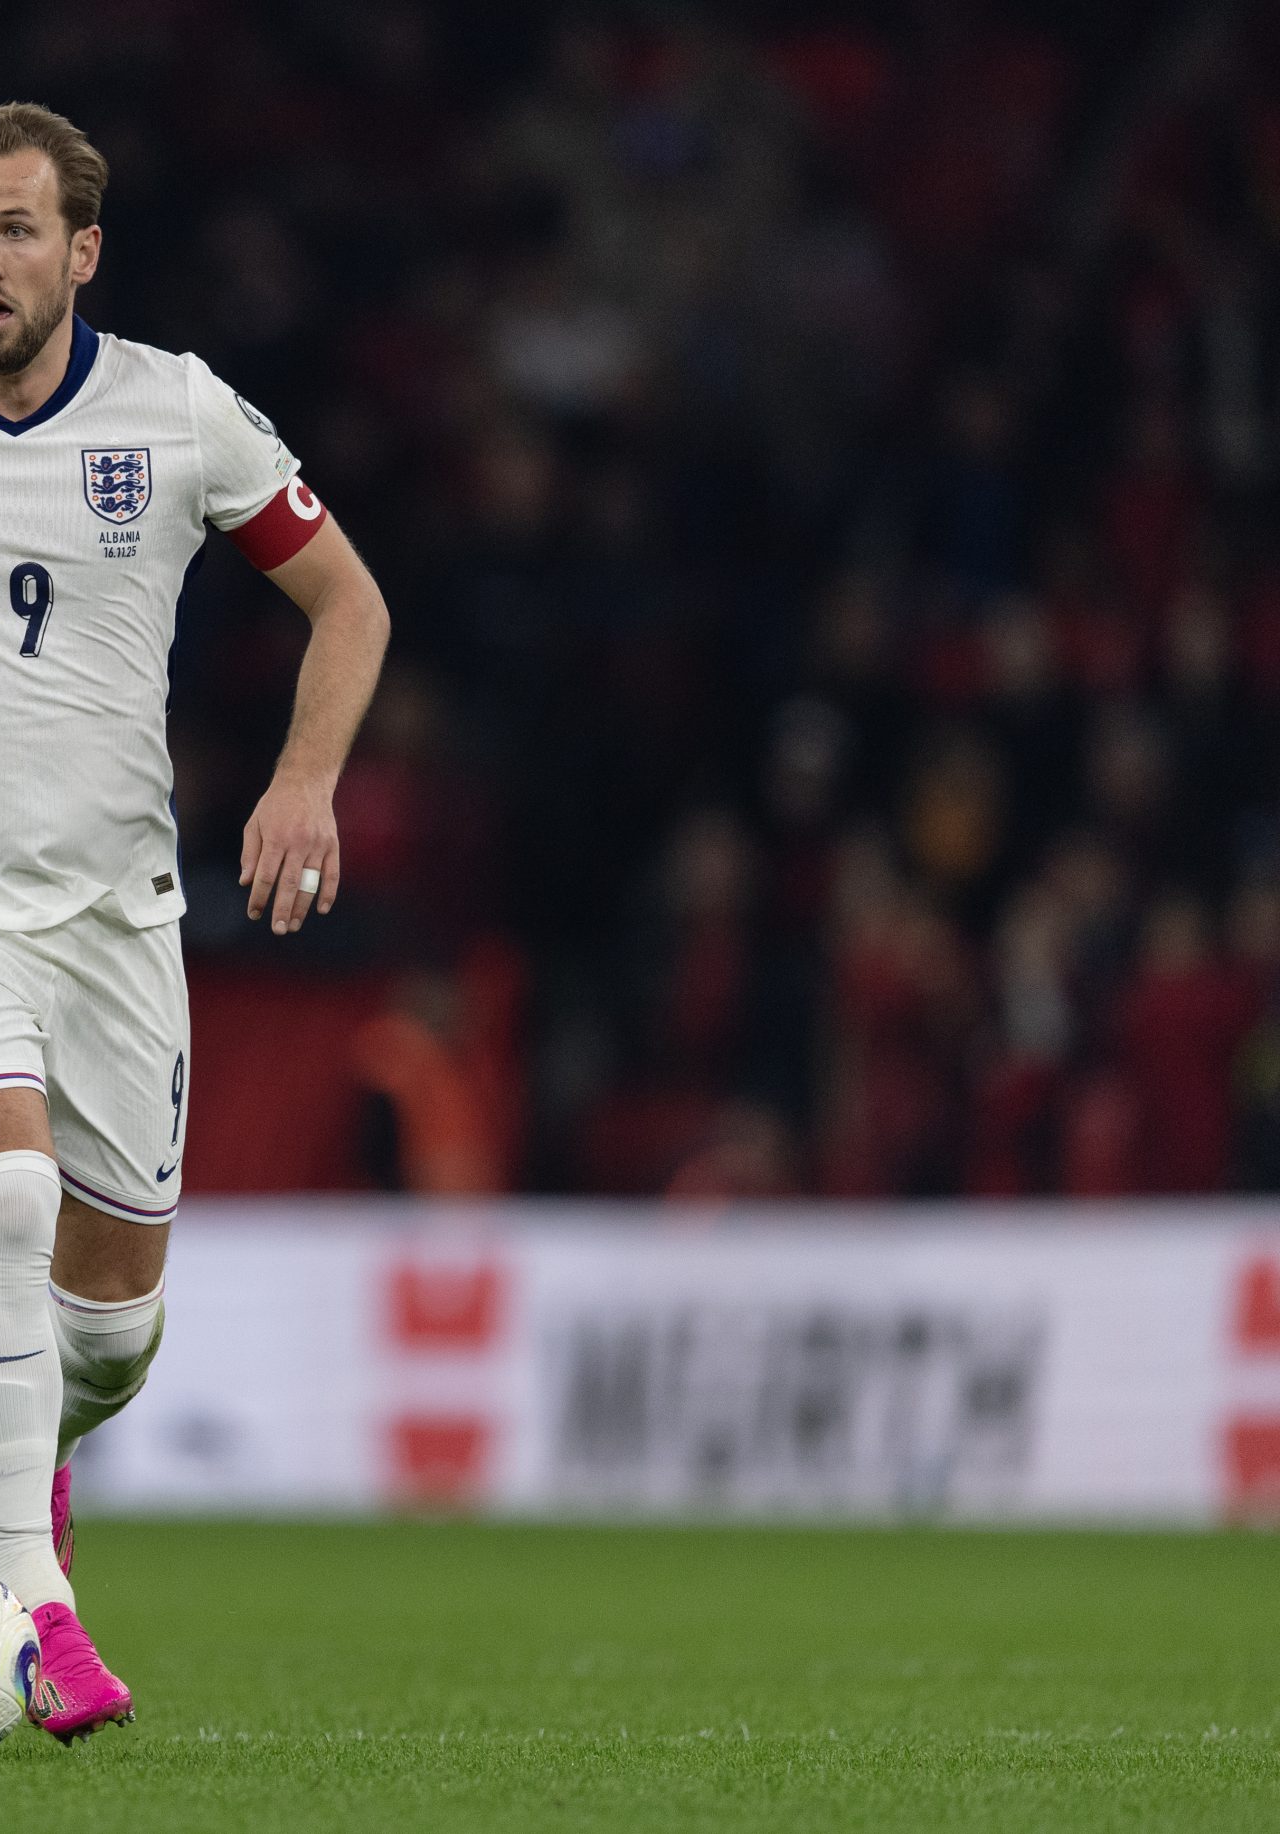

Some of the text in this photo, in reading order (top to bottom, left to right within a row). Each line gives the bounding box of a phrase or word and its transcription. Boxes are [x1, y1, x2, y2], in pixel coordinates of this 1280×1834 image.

[286, 476, 321, 520] C
[99, 531, 140, 543] ALBANIA
[104, 545, 136, 558] 16.11.25
[9, 562, 54, 657] 9
[171, 1050, 184, 1147] 9
